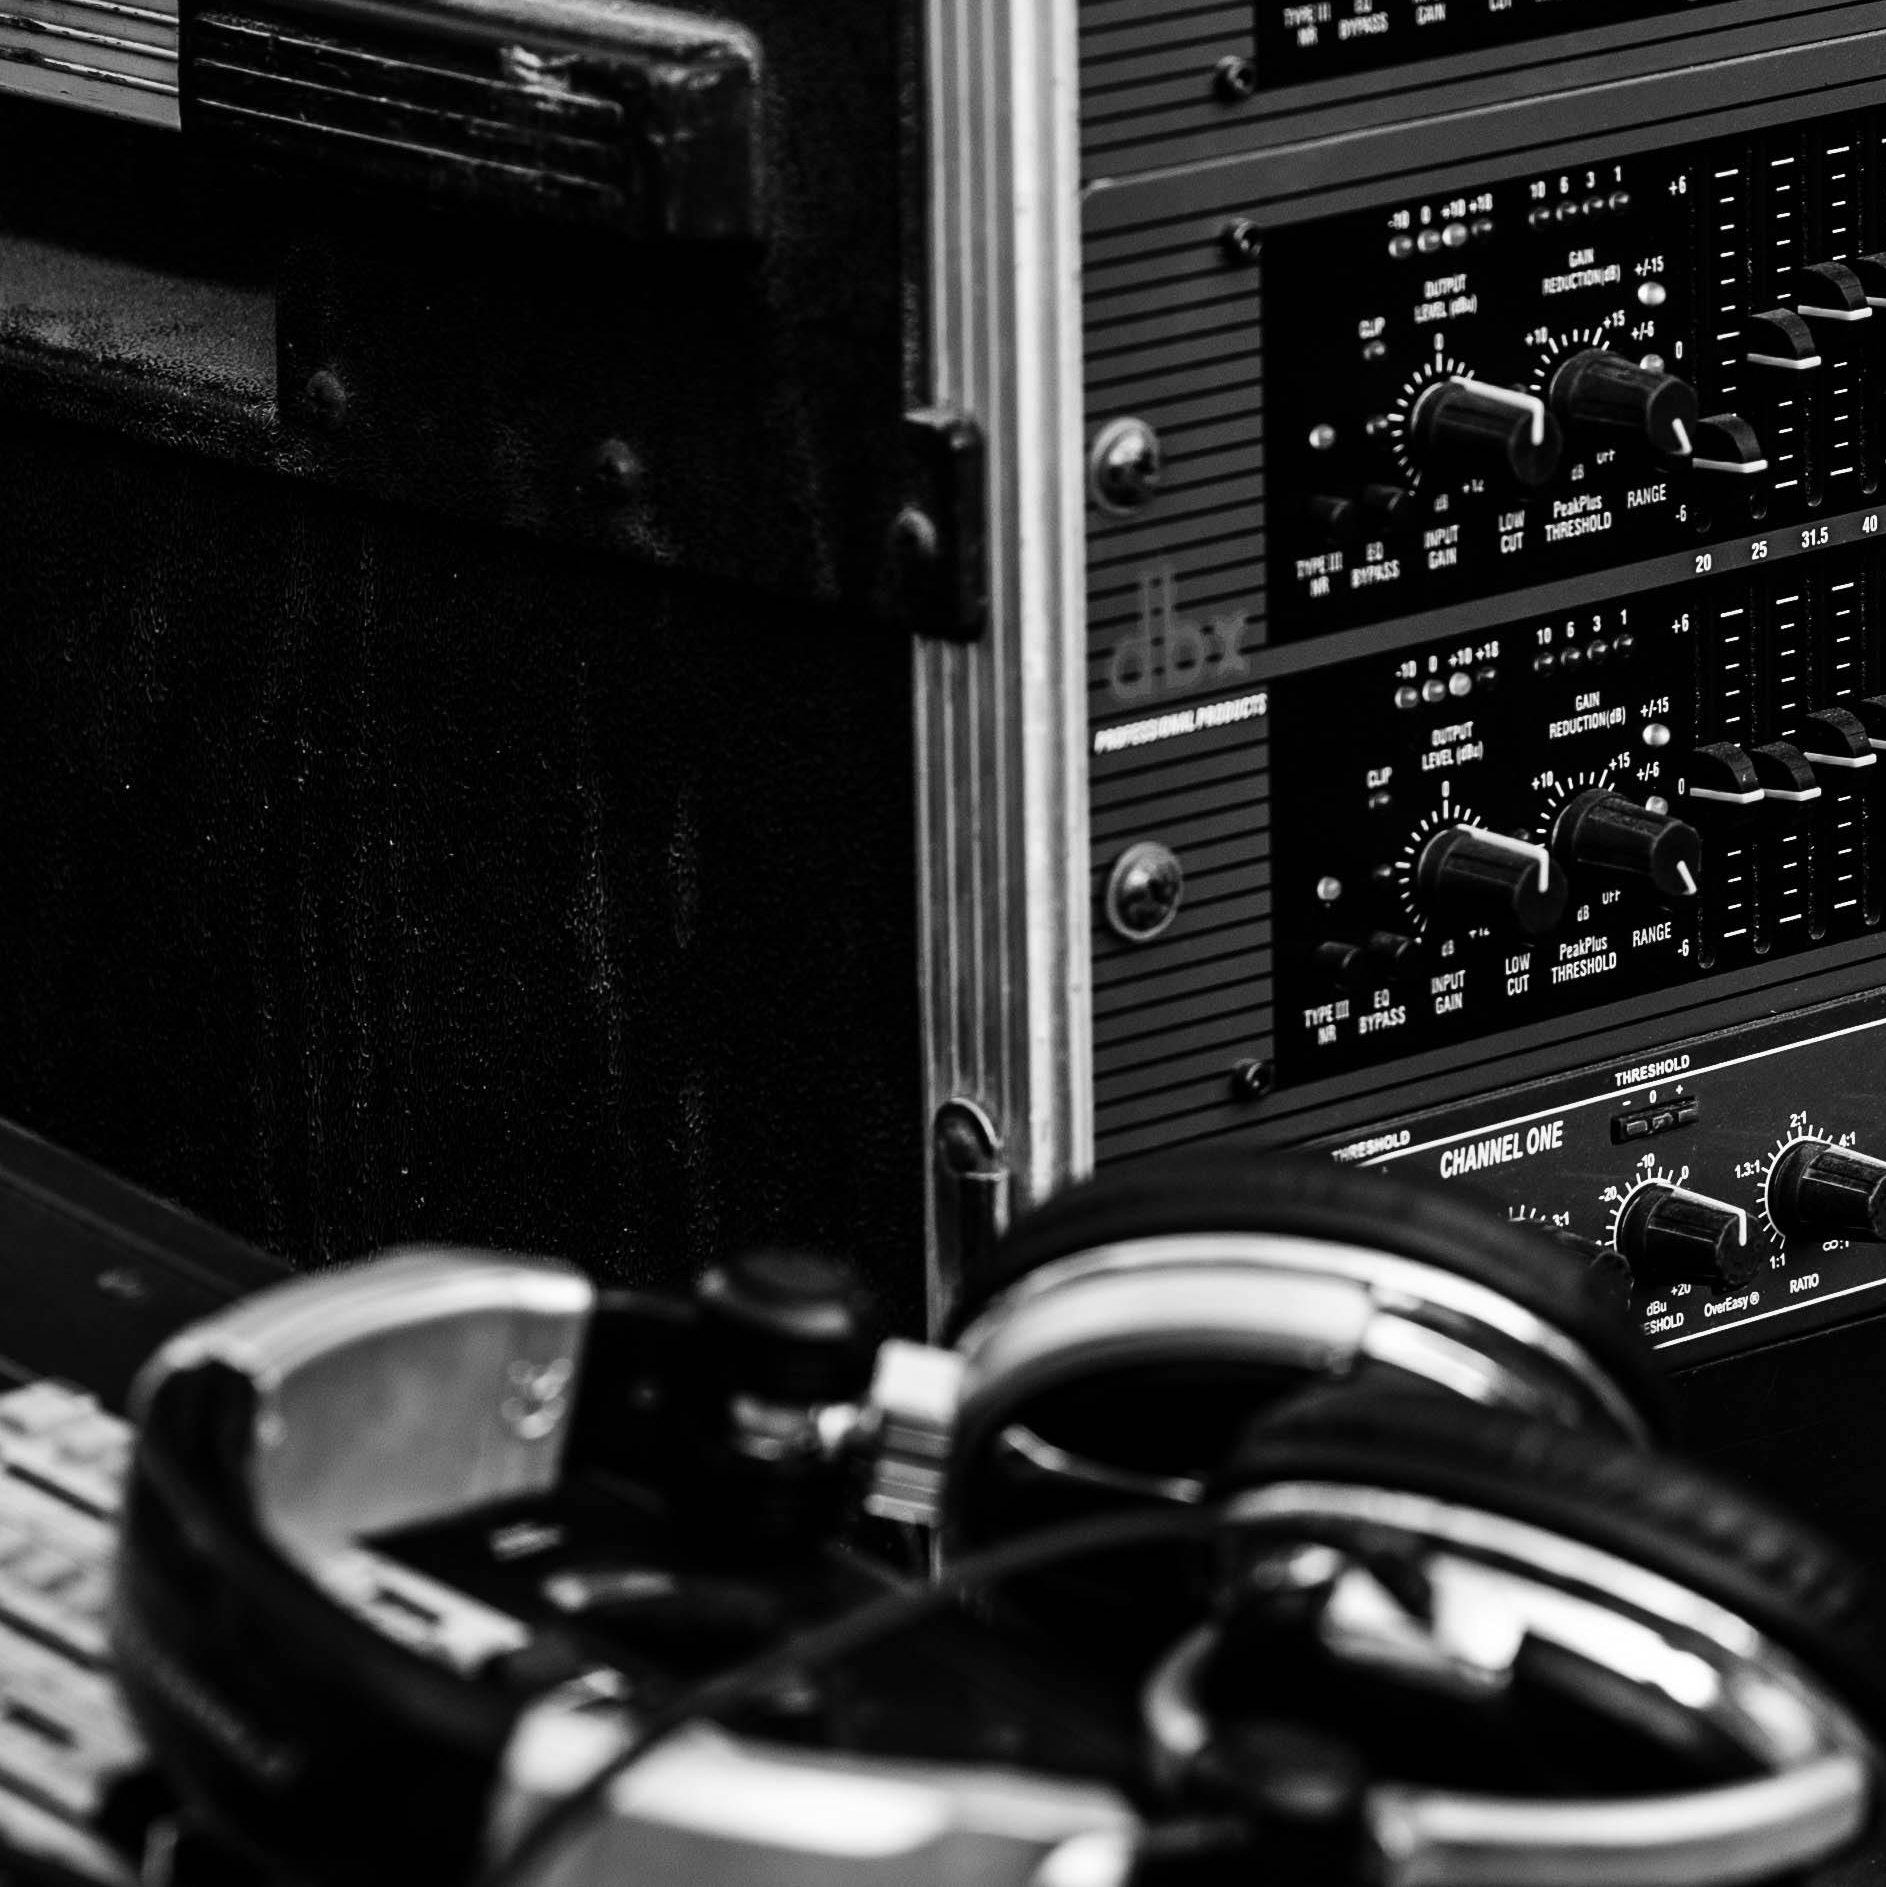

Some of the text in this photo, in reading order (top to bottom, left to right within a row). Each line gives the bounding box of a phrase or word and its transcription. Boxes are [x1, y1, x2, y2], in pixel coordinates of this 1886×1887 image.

[1628, 484, 1666, 508] RANGE
[1545, 512, 1611, 541] THRESHOLD
[1696, 554, 1711, 573] 20
[1752, 541, 1767, 560] 25
[1802, 527, 1828, 548] 31.5
[1862, 515, 1877, 533] 40
[1672, 614, 1689, 633] +6
[1576, 692, 1600, 711] GAIN
[1640, 697, 1669, 717] +/-15
[1550, 706, 1625, 738] REDUCTION(dB)
[1432, 721, 1473, 746] OUTPUT
[1637, 762, 1659, 781] +/-6
[1633, 922, 1671, 947] RANGE
[1560, 936, 1607, 960] PeakPlus
[1678, 939, 1689, 956] -6
[1506, 953, 1530, 975] LOW
[1551, 952, 1616, 984] THRESHOLD
[1432, 970, 1465, 994] INPUT
[1508, 974, 1529, 996] CUT
[1436, 992, 1462, 1014] GAIN
[1360, 1006, 1405, 1034] BYPASS
[1615, 1054, 1690, 1087] THRESHOLD
[1790, 1111, 1806, 1131] 2:1
[1440, 1120, 1563, 1178] CHANNEL ONE
[1836, 1131, 1856, 1152] 4:1
[1637, 1153, 1655, 1172] -10
[1735, 1160, 1760, 1178] 1.3:1
[1599, 1186, 1620, 1202] -20
[1770, 1253, 1785, 1269] 1:1
[1790, 1273, 1819, 1293] RATIO
[1647, 1301, 1667, 1316] dBu
[1704, 1296, 1748, 1317] OverEasy
